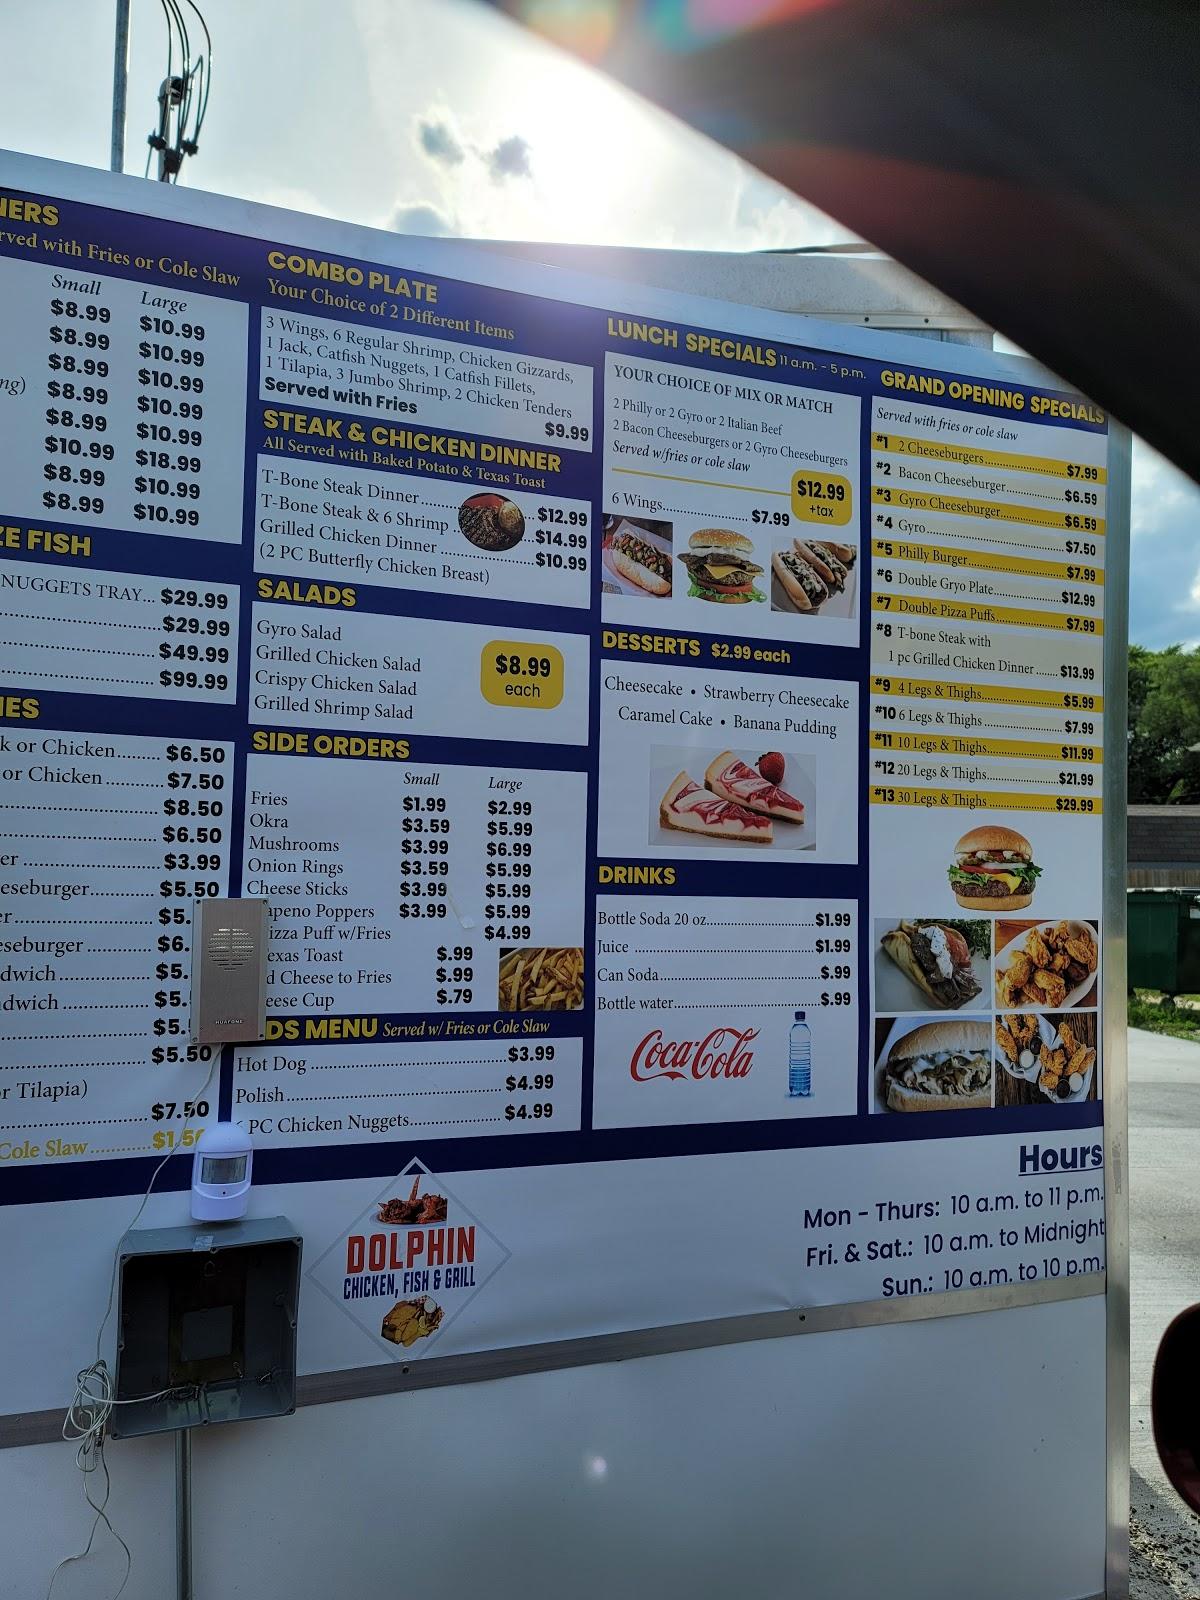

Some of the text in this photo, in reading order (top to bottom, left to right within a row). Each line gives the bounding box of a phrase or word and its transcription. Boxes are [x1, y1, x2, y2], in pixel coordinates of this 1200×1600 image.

[268, 251, 438, 303] COMBO PLATE
[52, 274, 187, 313] Small Large
[51, 299, 205, 341] $8.99 $10.99
[267, 278, 514, 340] Your Choice of 2 Different Items
[607, 318, 866, 379] LUNCH SPECIALS 11 a.m. 5 p.m.
[265, 377, 417, 414] Served with Fries
[614, 365, 833, 414] YOUR CHOICE OF MIX OR MATCH
[881, 370, 1105, 424] GRAND OPENING SPECIALS
[545, 422, 589, 442] $9.99
[877, 407, 1018, 441] Served with fries or cole slaw
[264, 409, 561, 472] STEAK & CHICKEN DINNER
[263, 436, 546, 489] All Served with Baked Potato & Texas Toast
[797, 479, 845, 501] $12.99
[810, 504, 833, 518] +tax
[27, 529, 91, 557] FISH
[260, 541, 490, 586] (2 PC Butterfly Chicken Breast)
[1, 574, 228, 610] NUGGETS TRAY $29.99
[257, 578, 357, 607] SALADS
[877, 569, 1095, 607] #6 Double Gryo $12.99
[257, 619, 341, 641] Gyro Salad
[602, 630, 791, 664] DESSERTS $2.99 each
[159, 669, 228, 690] $99.99
[495, 653, 551, 678] $8.99
[889, 651, 1094, 680] 1 pc Grilled Chicken Dinner $13.99
[505, 682, 540, 698] each
[604, 676, 850, 709] Cheesecake Strawberry Cheesecake
[619, 706, 837, 739] Caramel Cake Banana Pudding
[17, 739, 225, 763] or Chicken $6.50
[253, 730, 410, 759] SIDE ORDERS
[404, 772, 523, 793] Small Large
[875, 761, 1094, 786] #12 20 Legs & Thighs $21.99
[163, 799, 223, 818] $8.50
[251, 790, 532, 817] Fries $1.99 $2.99
[248, 859, 344, 878] Onion Rings
[598, 866, 676, 885] DRINKS
[597, 911, 851, 927] Bottle Soda 20 oz $1.99
[302, 988, 473, 1009] Cup $.79
[305, 1018, 550, 1039] MENU Served w/ Fries or Cole Slaw
[151, 1045, 212, 1064] $5.50
[238, 1045, 555, 1075] Hot Dog $3.99
[630, 1028, 761, 1082] Coca-Cola
[16, 1079, 88, 1102] Tilapia)
[236, 1074, 555, 1103] Polish $4.99
[1019, 1144, 1103, 1172] Hours
[804, 1186, 1104, 1229] Mon Thurs: 10 a.m. to 11 p.m.
[346, 1226, 475, 1274] DOLPHIN
[806, 1219, 1105, 1267] Fri. & Sat.: 10 a.m. to Midnight
[343, 1266, 476, 1300] CHICKEN, FISH & GRILL
[882, 1255, 1105, 1297] Sun.: 10 a.m. to 10 p.m.
